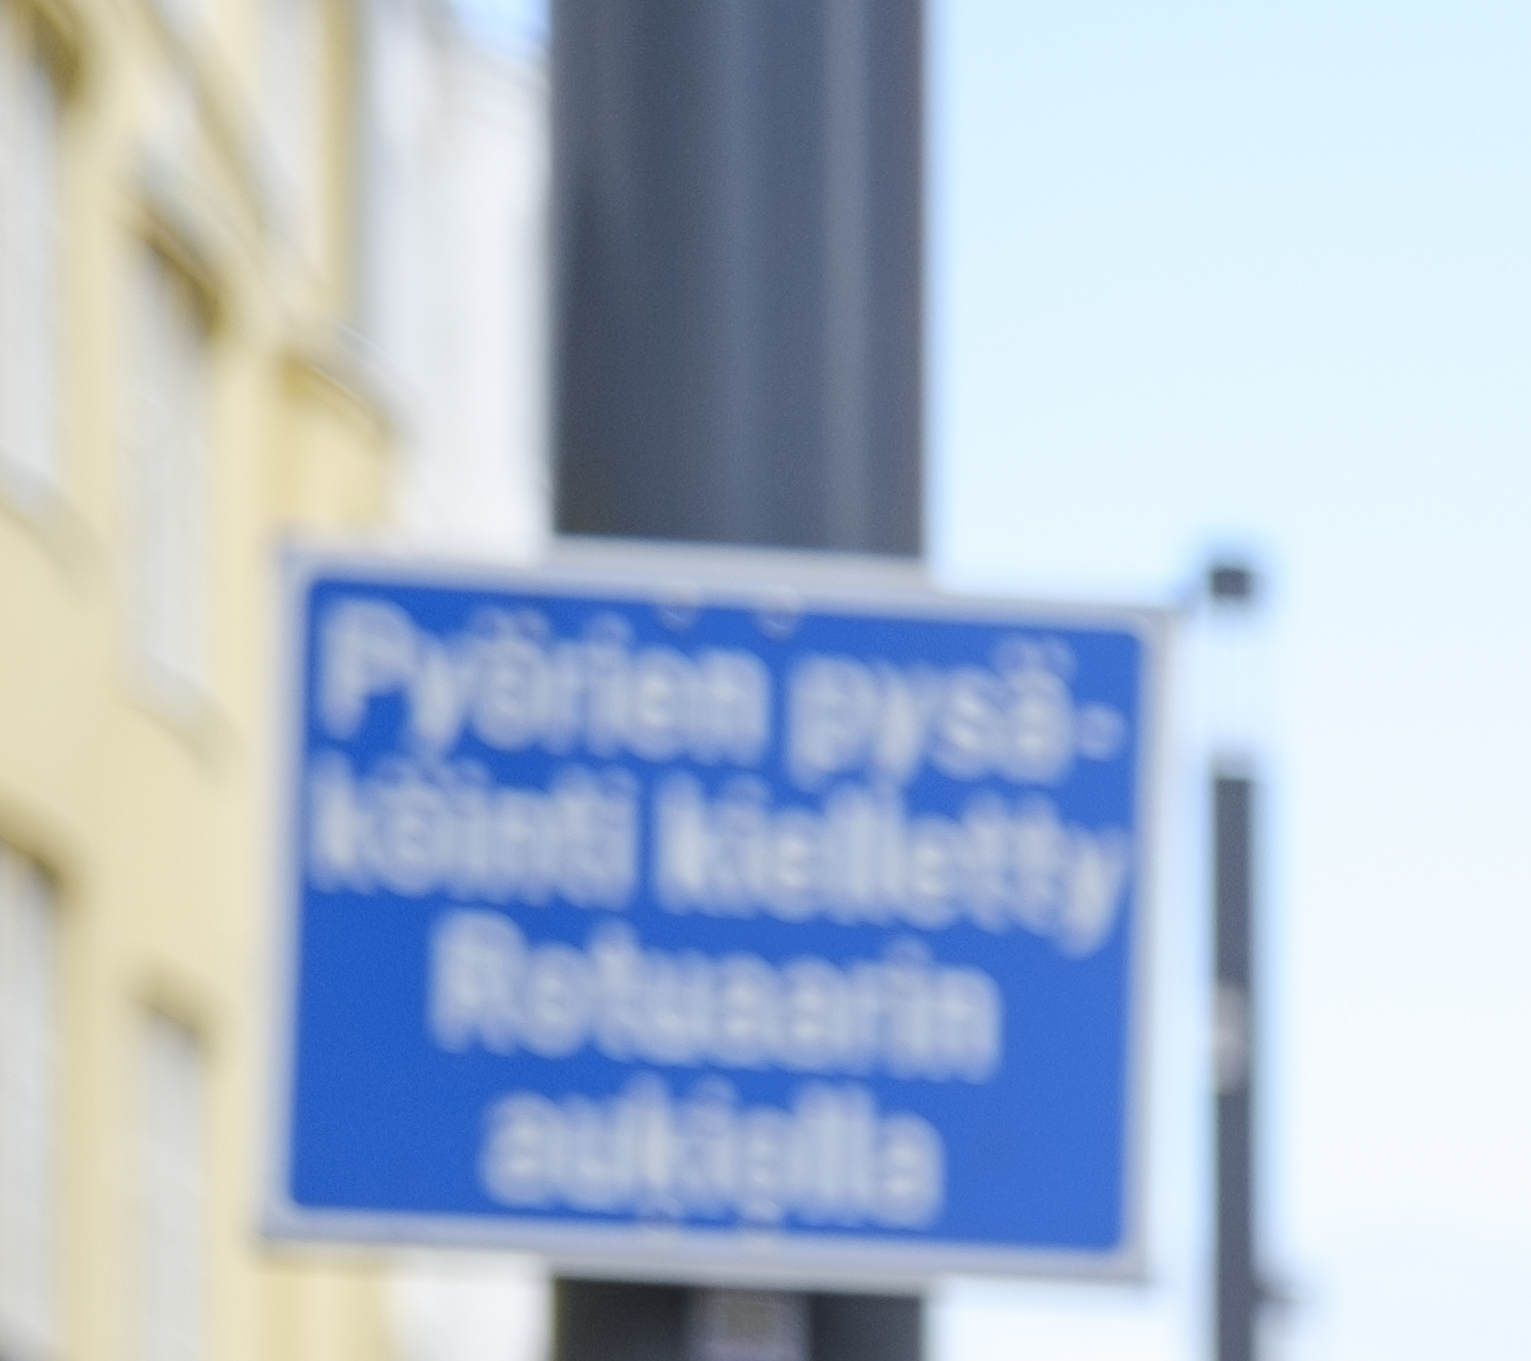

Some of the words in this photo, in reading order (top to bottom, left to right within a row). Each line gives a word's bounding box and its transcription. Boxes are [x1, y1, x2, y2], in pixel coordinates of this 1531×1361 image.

[318, 600, 770, 762] Pyörien
[790, 637, 1123, 789] pysä-
[309, 748, 640, 905] köinti
[657, 772, 1126, 957] kielletty
[430, 909, 1000, 1083] Rotuaarin
